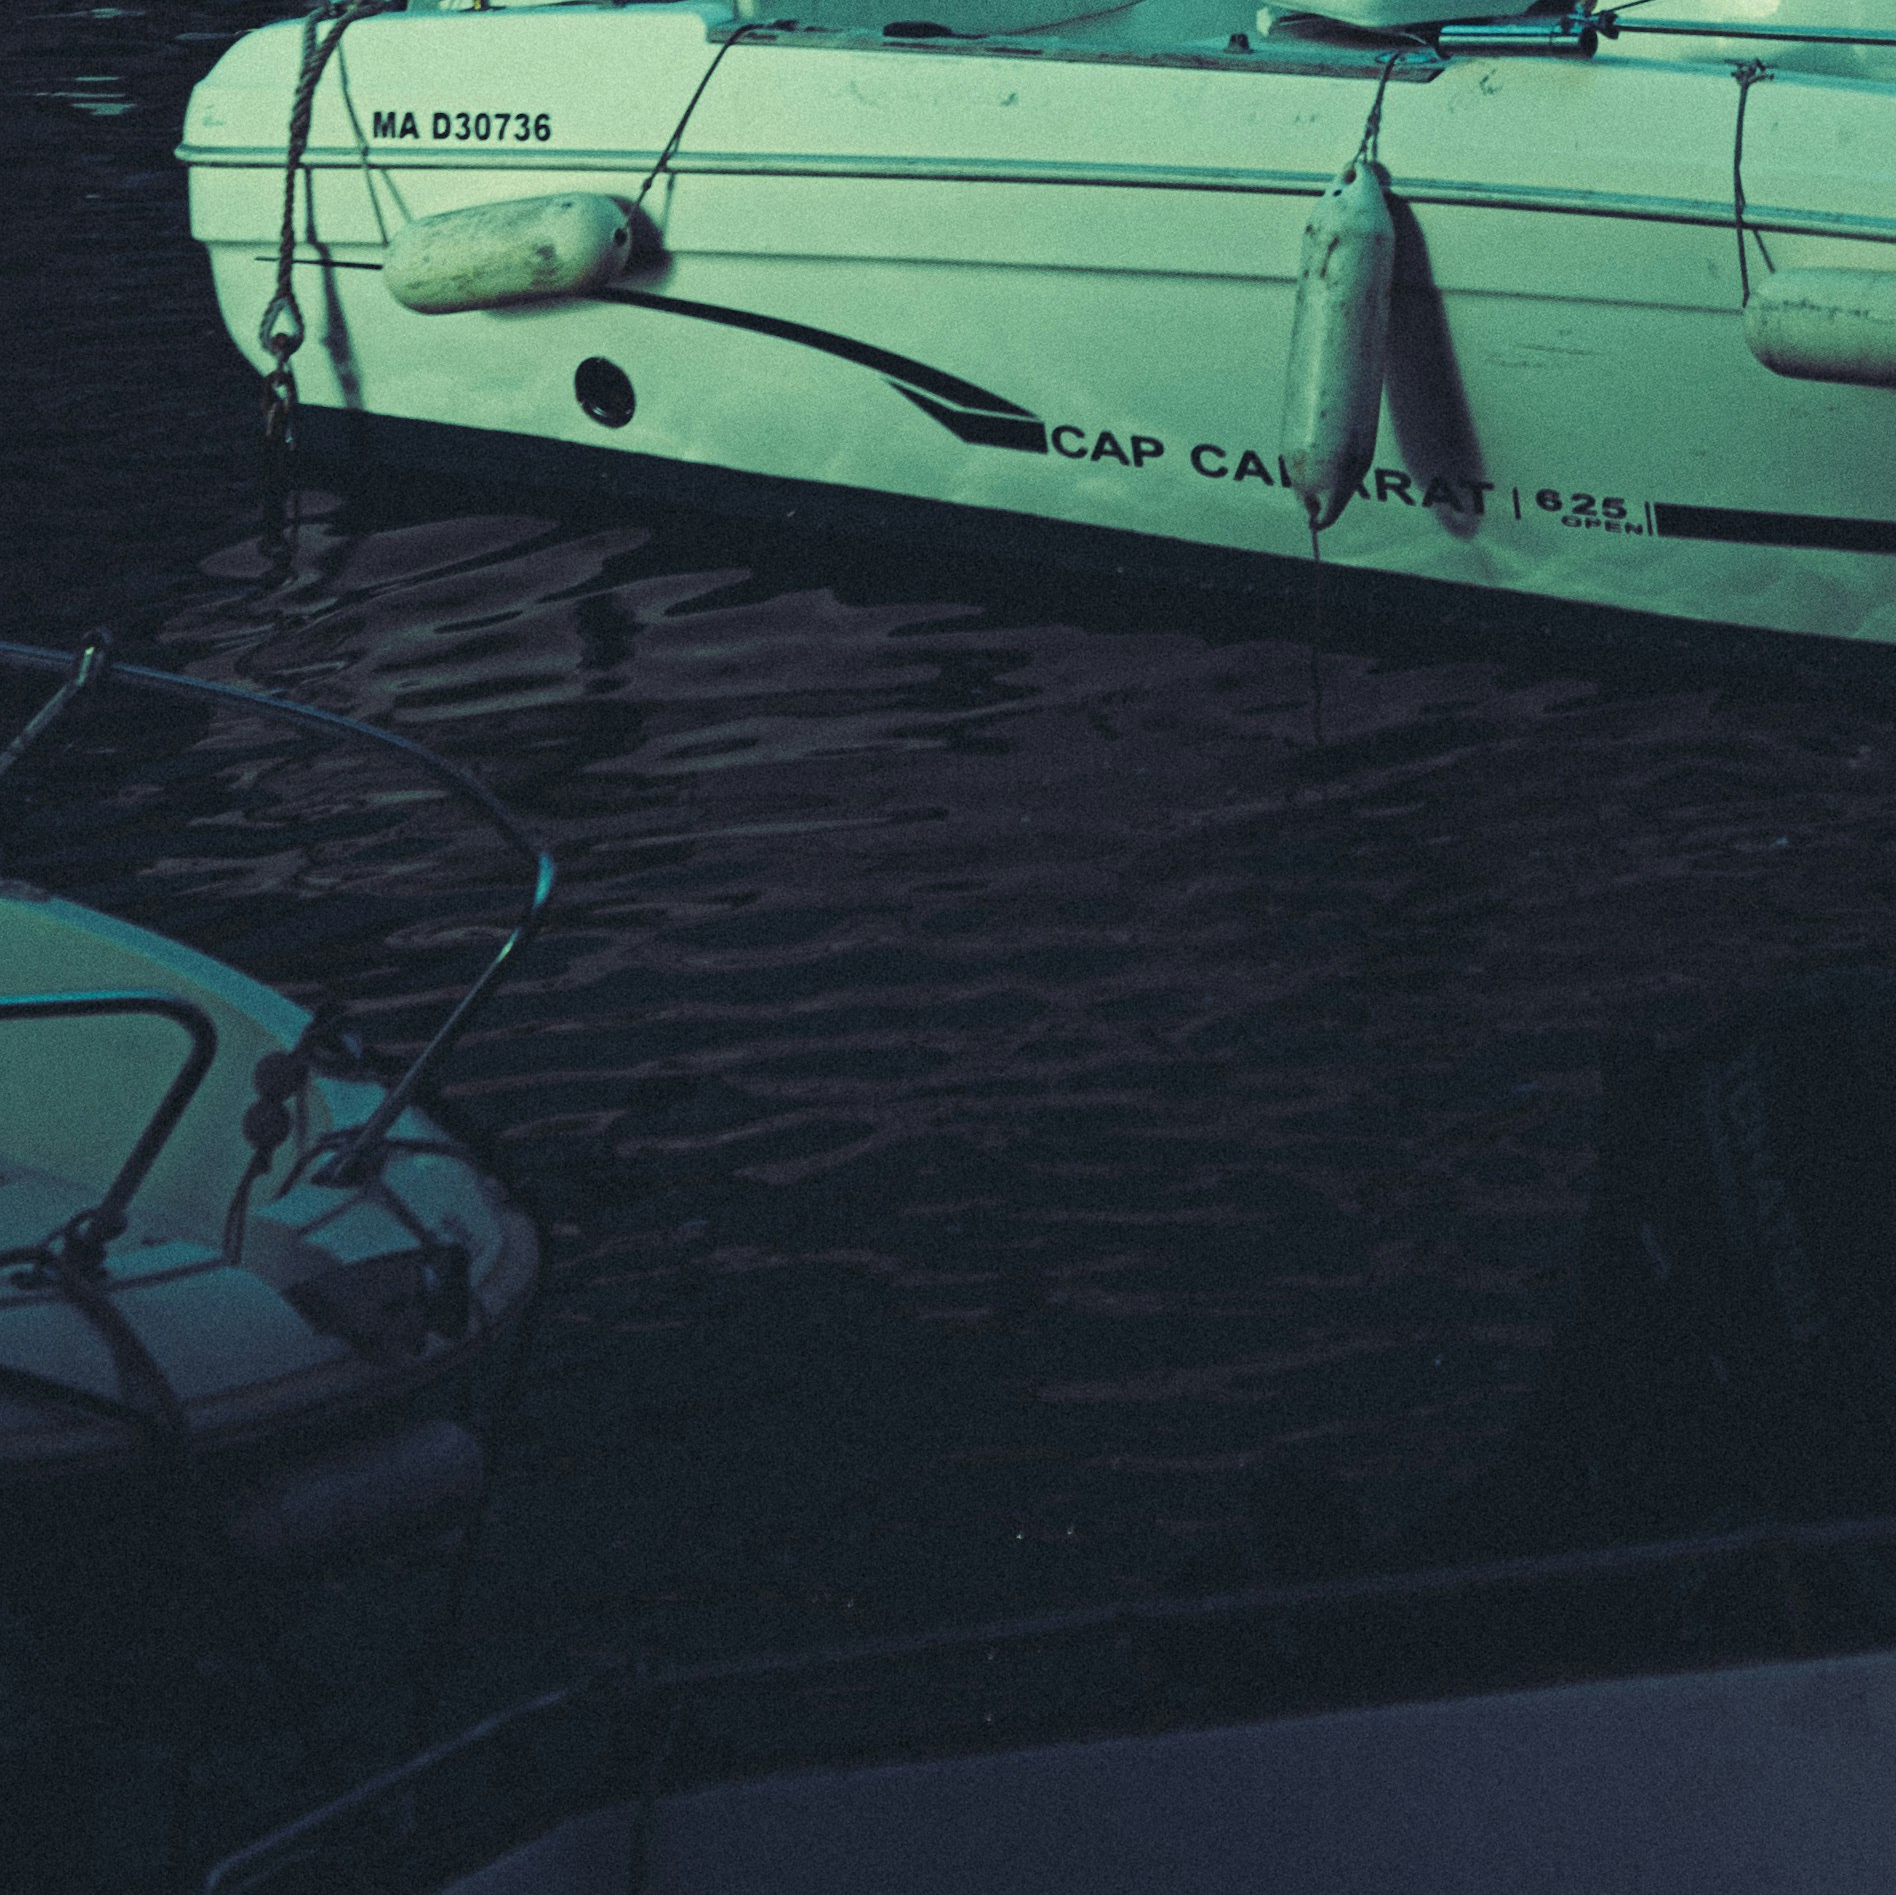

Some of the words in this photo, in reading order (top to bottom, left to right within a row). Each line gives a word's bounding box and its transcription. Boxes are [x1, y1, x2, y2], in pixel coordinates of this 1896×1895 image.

[374, 111, 420, 140] MA
[433, 112, 551, 141] D30736
[1050, 424, 1165, 468] CAP
[1189, 443, 1495, 516] CARAT
[1535, 488, 1628, 520] 625
[1560, 514, 1644, 536] OPEN
